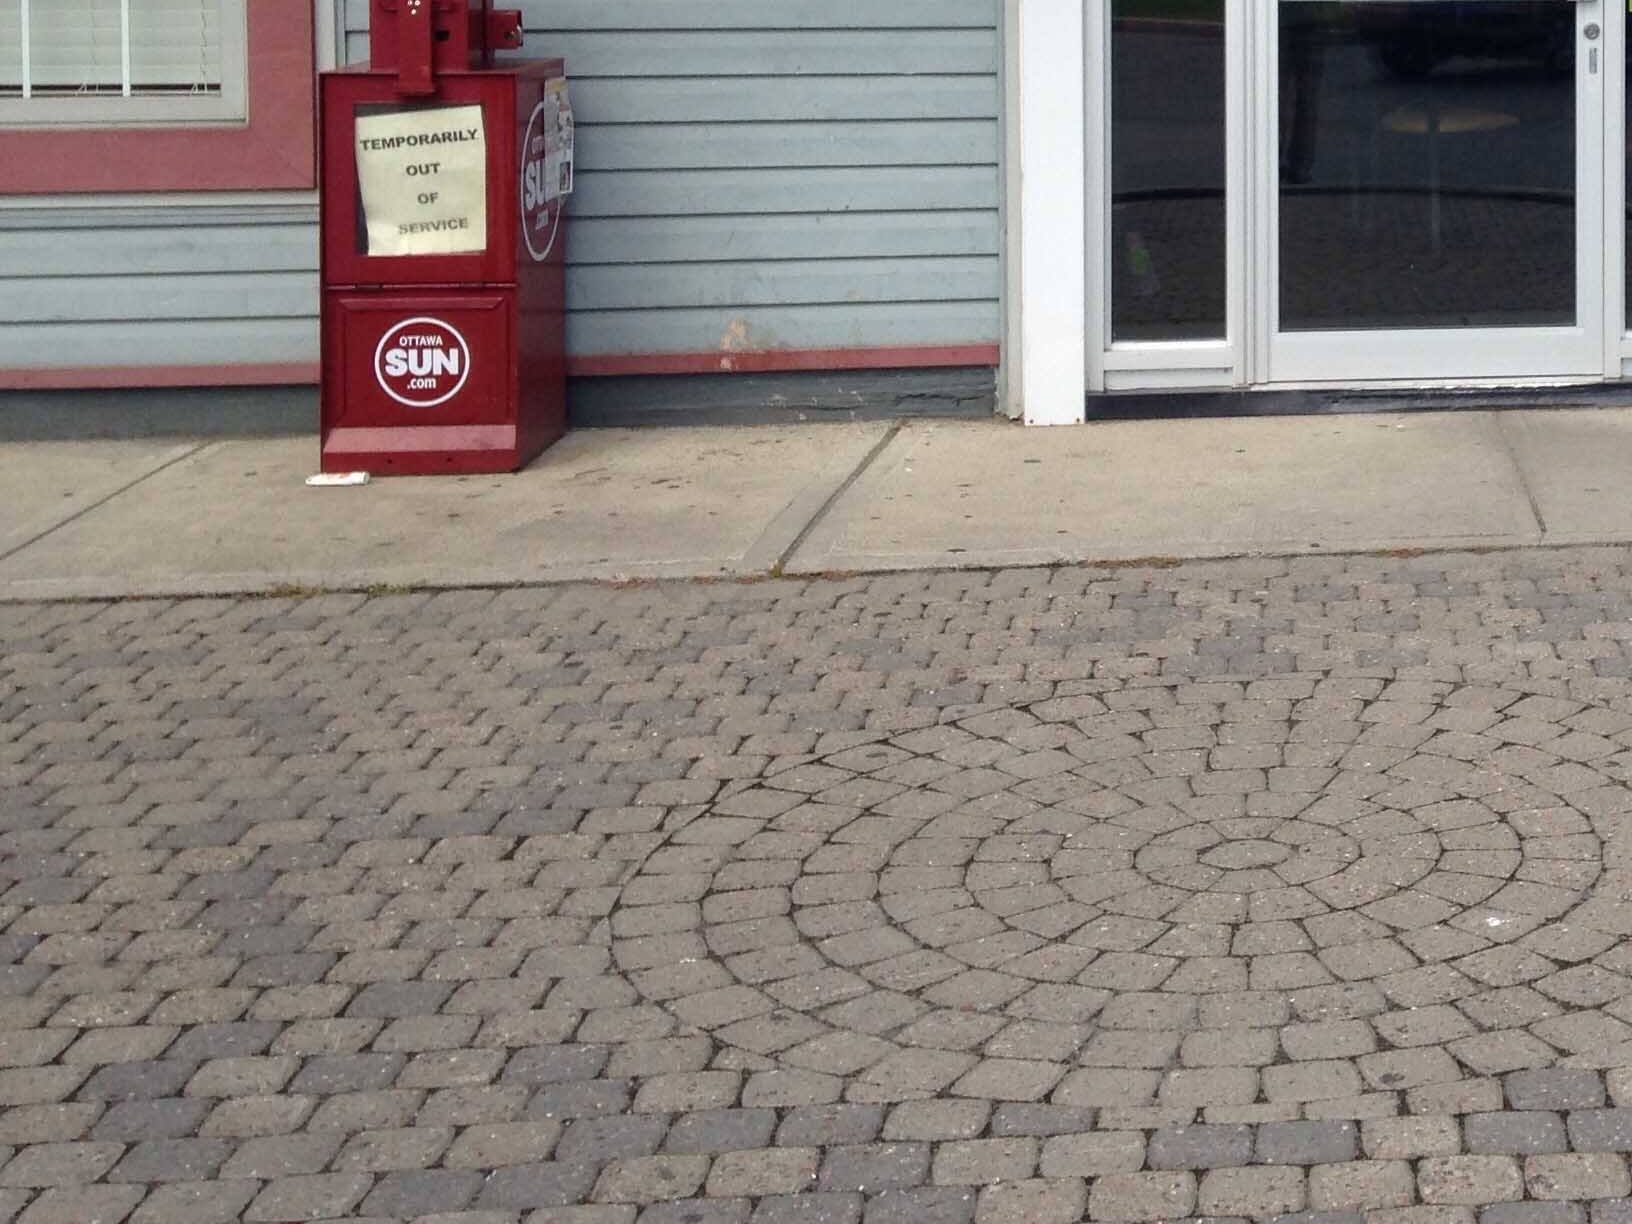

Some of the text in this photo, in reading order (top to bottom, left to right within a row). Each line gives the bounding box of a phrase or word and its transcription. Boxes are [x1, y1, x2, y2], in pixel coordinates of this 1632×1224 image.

[360, 127, 479, 152] TEMPORARILY
[405, 162, 441, 177] OUT
[525, 160, 546, 211] SU
[416, 191, 440, 205] OF
[397, 216, 470, 235] SERVICE
[399, 335, 444, 347] OTTAWA
[384, 348, 460, 377] SUN
[406, 377, 437, 390] .com
